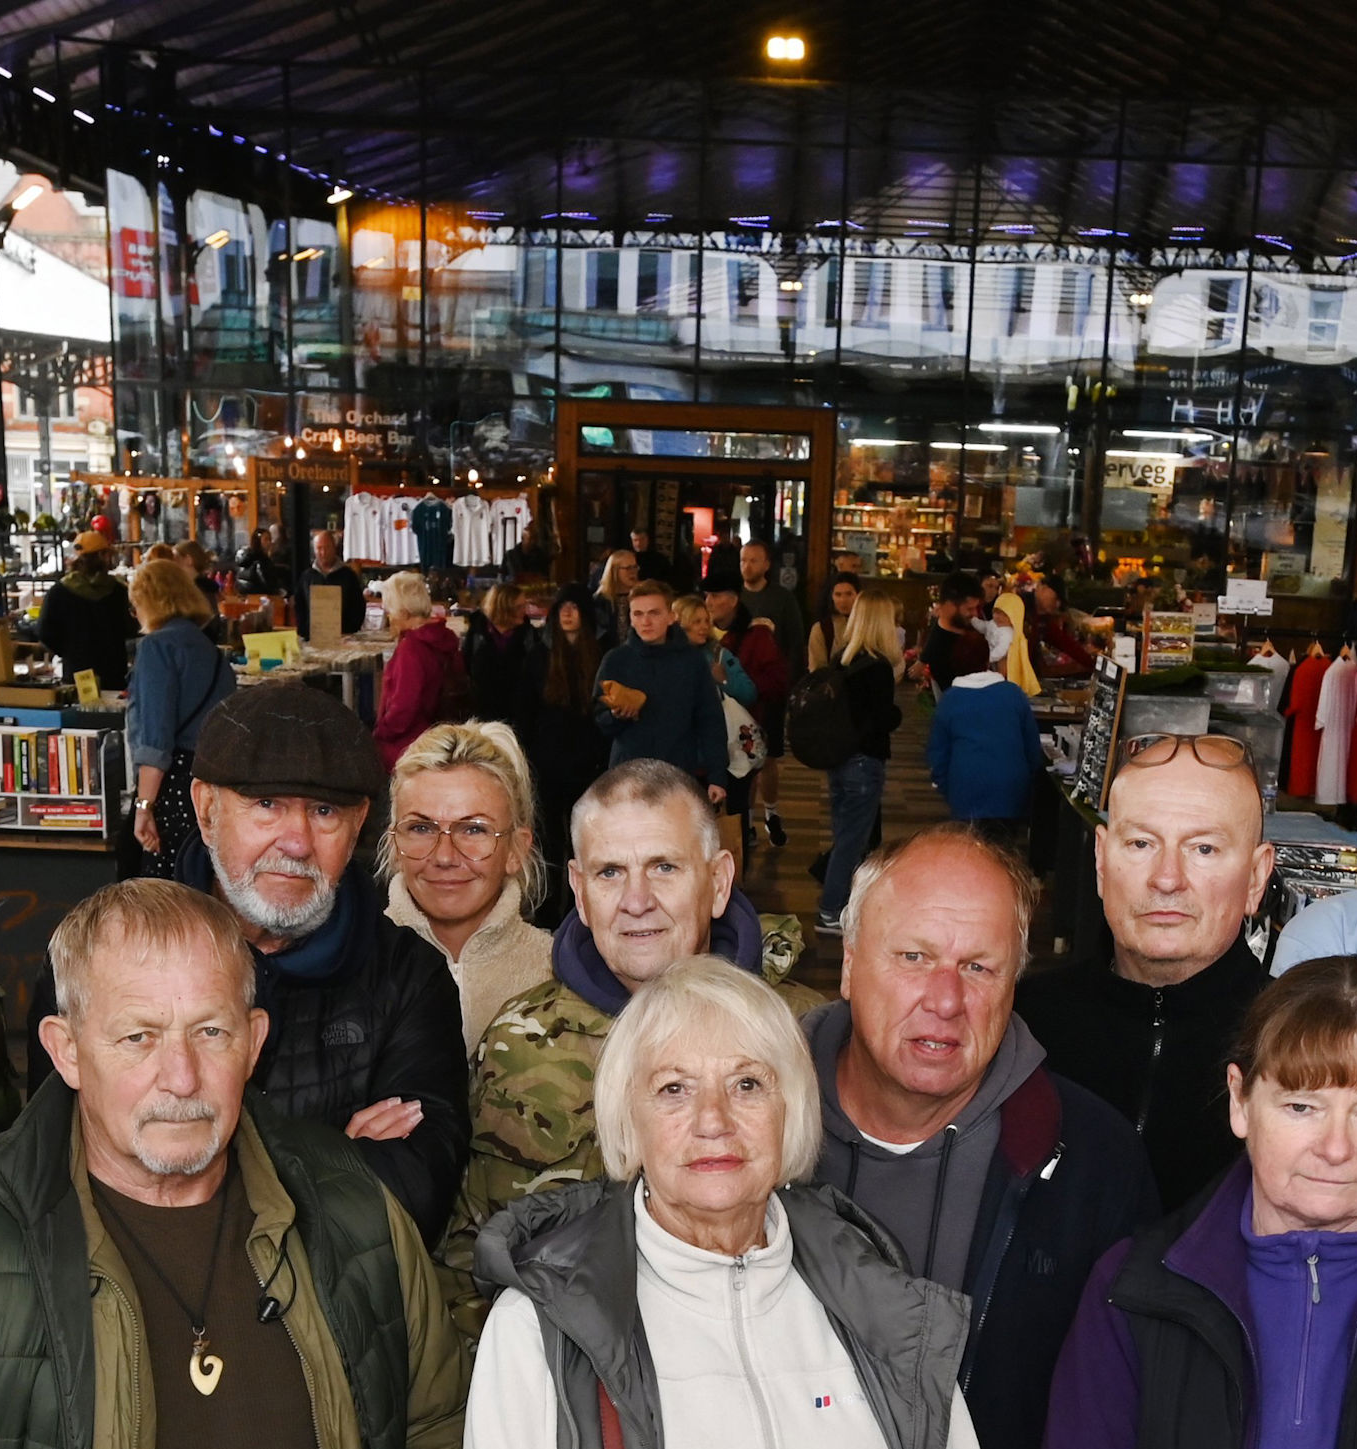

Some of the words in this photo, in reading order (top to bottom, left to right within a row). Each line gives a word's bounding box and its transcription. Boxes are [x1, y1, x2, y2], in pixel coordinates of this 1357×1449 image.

[313, 411, 341, 423] The
[346, 411, 408, 425] Orchard
[301, 428, 340, 443] Craft
[345, 429, 382, 444] Beer
[387, 431, 415, 445] Bar
[259, 463, 284, 478] The
[288, 463, 348, 480] Orchard
